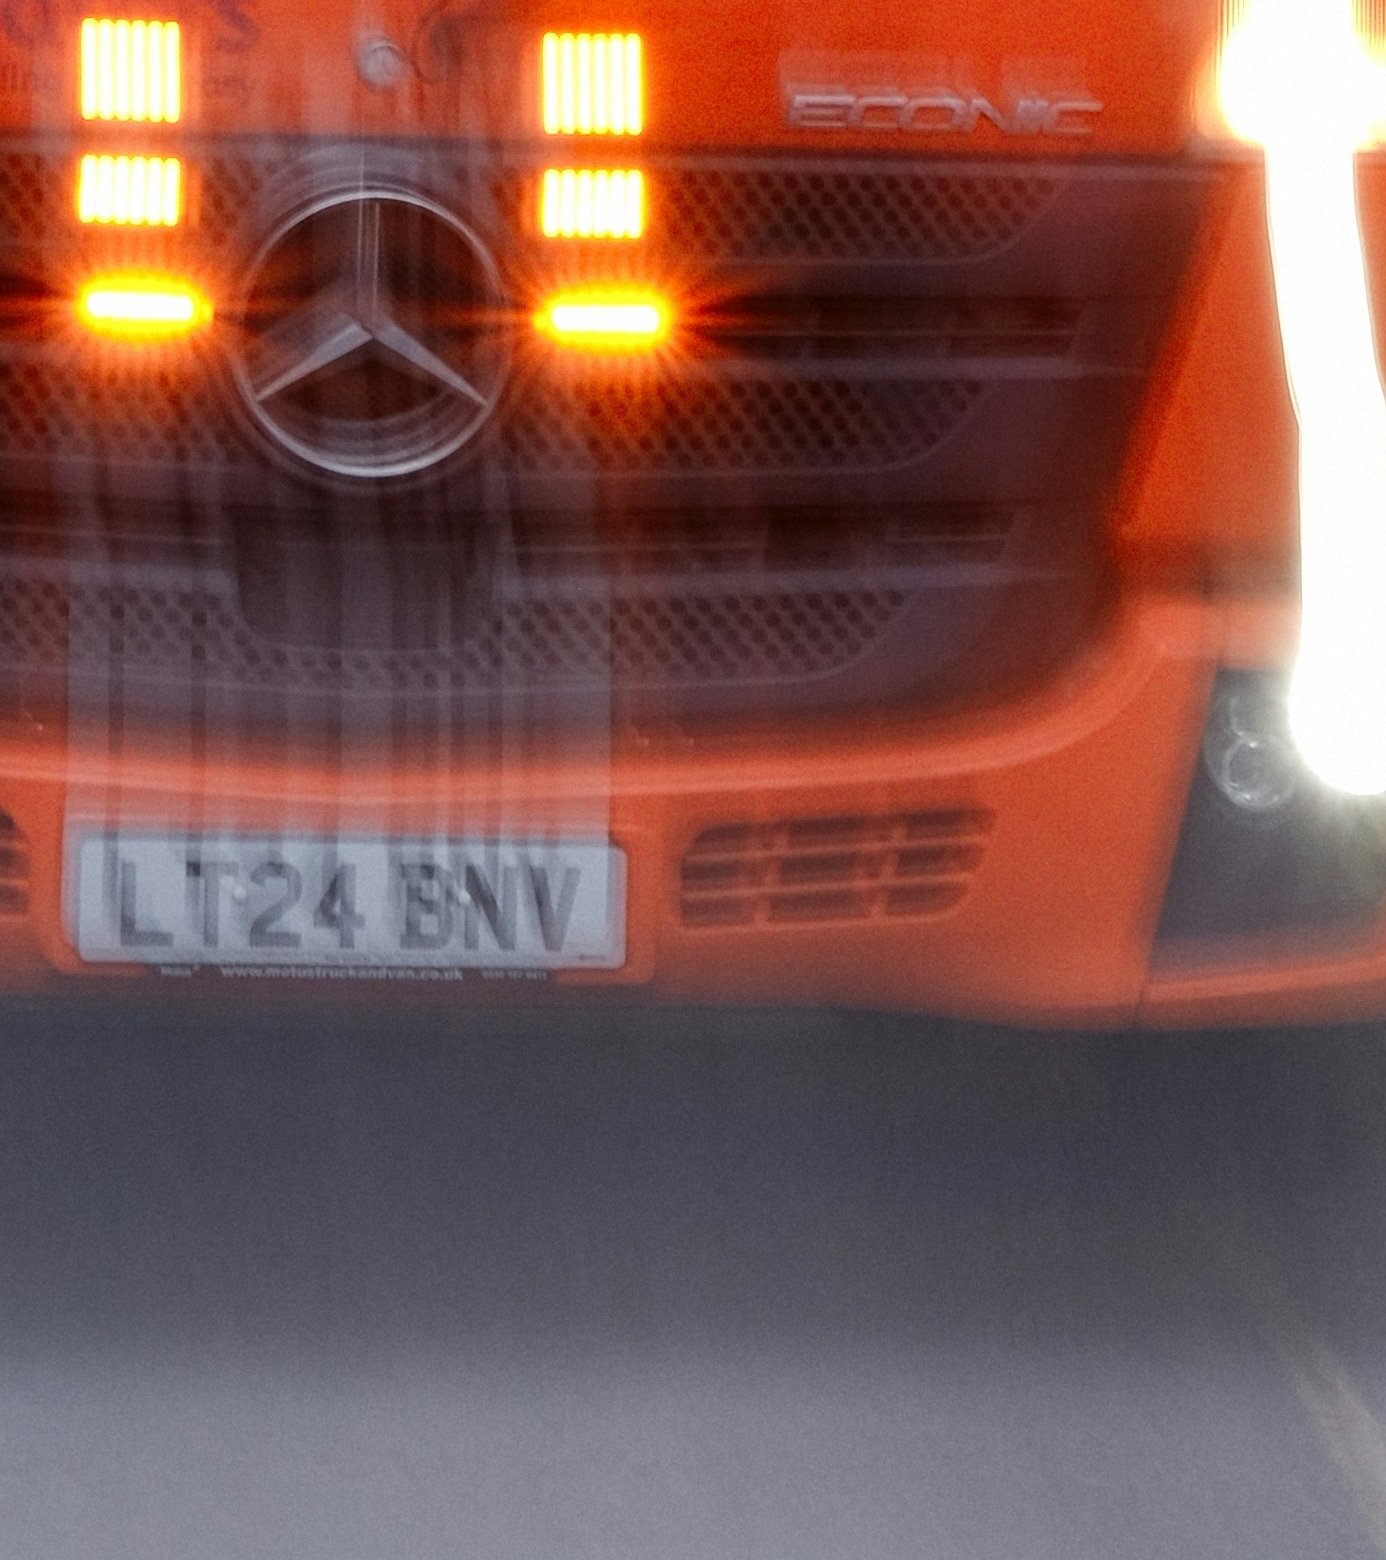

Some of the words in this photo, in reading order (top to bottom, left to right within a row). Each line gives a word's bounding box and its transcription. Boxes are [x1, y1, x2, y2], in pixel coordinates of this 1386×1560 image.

[789, 92, 1105, 135] ECONIC
[120, 861, 366, 950] LT24
[399, 864, 581, 953] BNV
